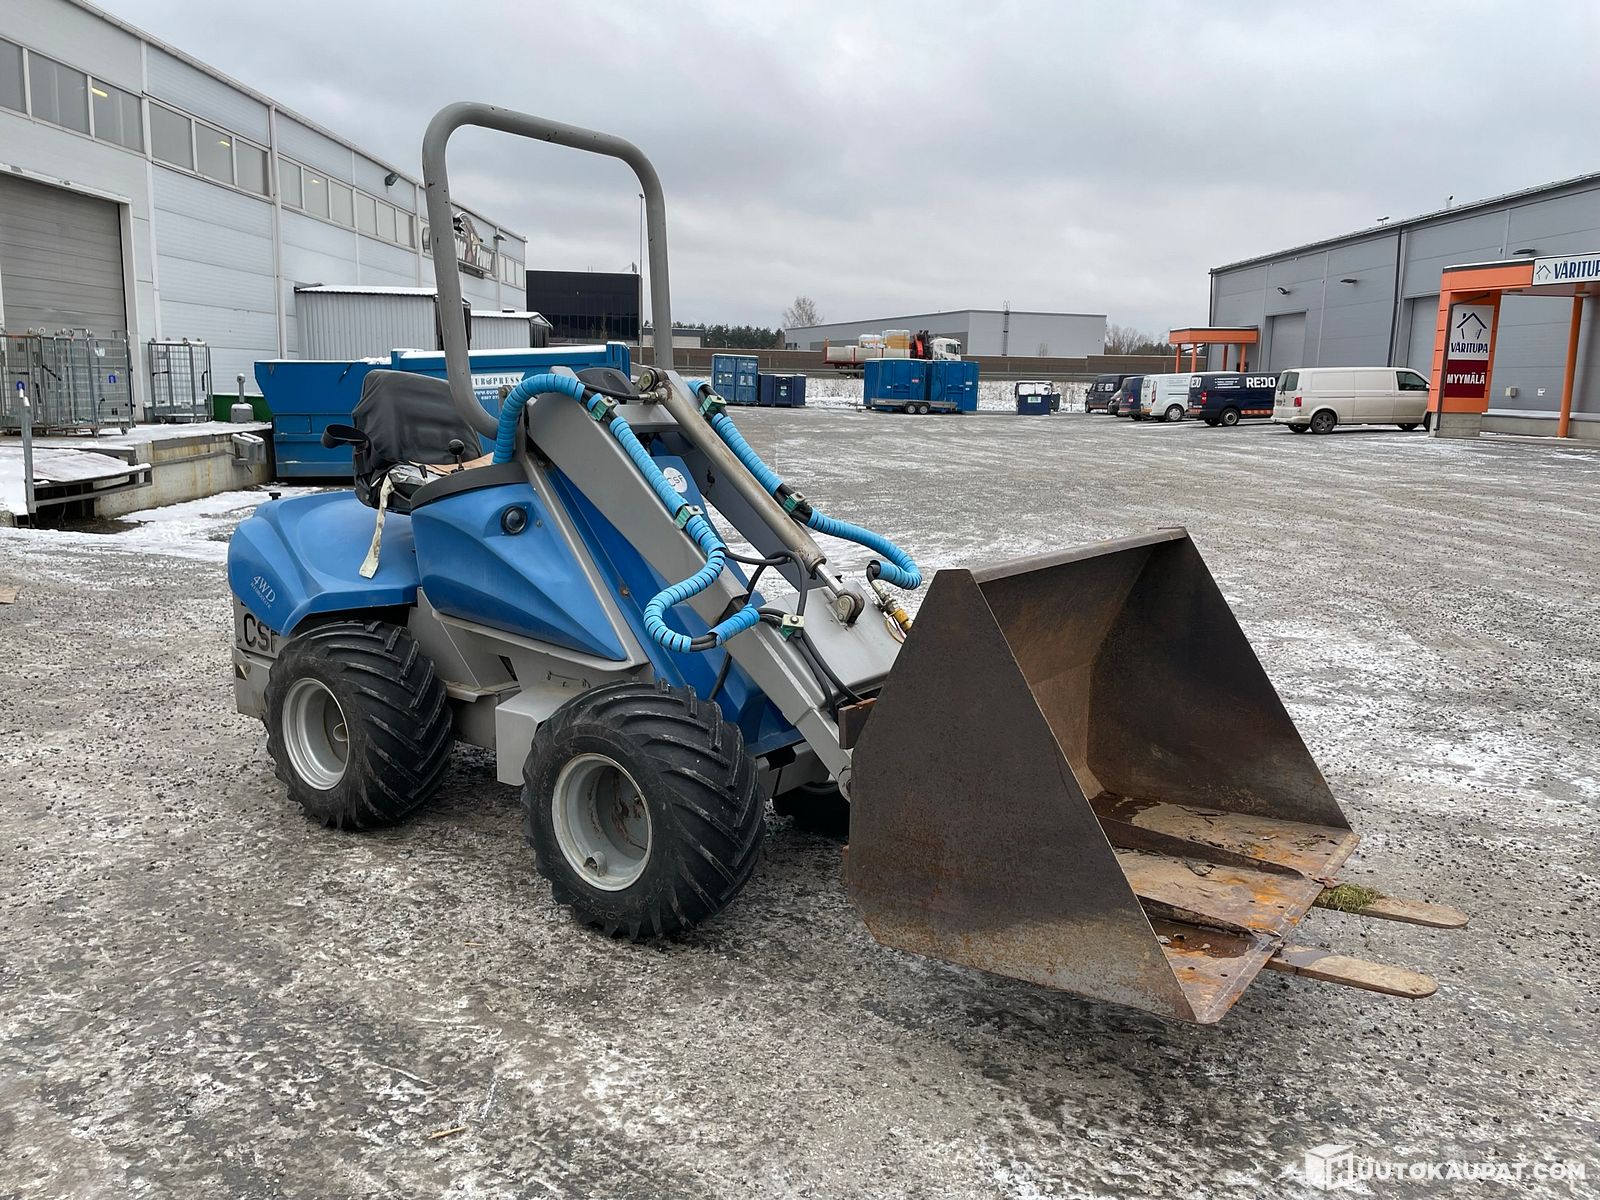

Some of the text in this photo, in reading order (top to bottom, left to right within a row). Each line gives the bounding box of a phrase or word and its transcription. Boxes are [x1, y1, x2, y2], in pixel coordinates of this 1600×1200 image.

[1246, 377, 1276, 388] REDO
[1446, 371, 1485, 384] MYYMÄLÄ
[253, 576, 276, 602] 4WD
